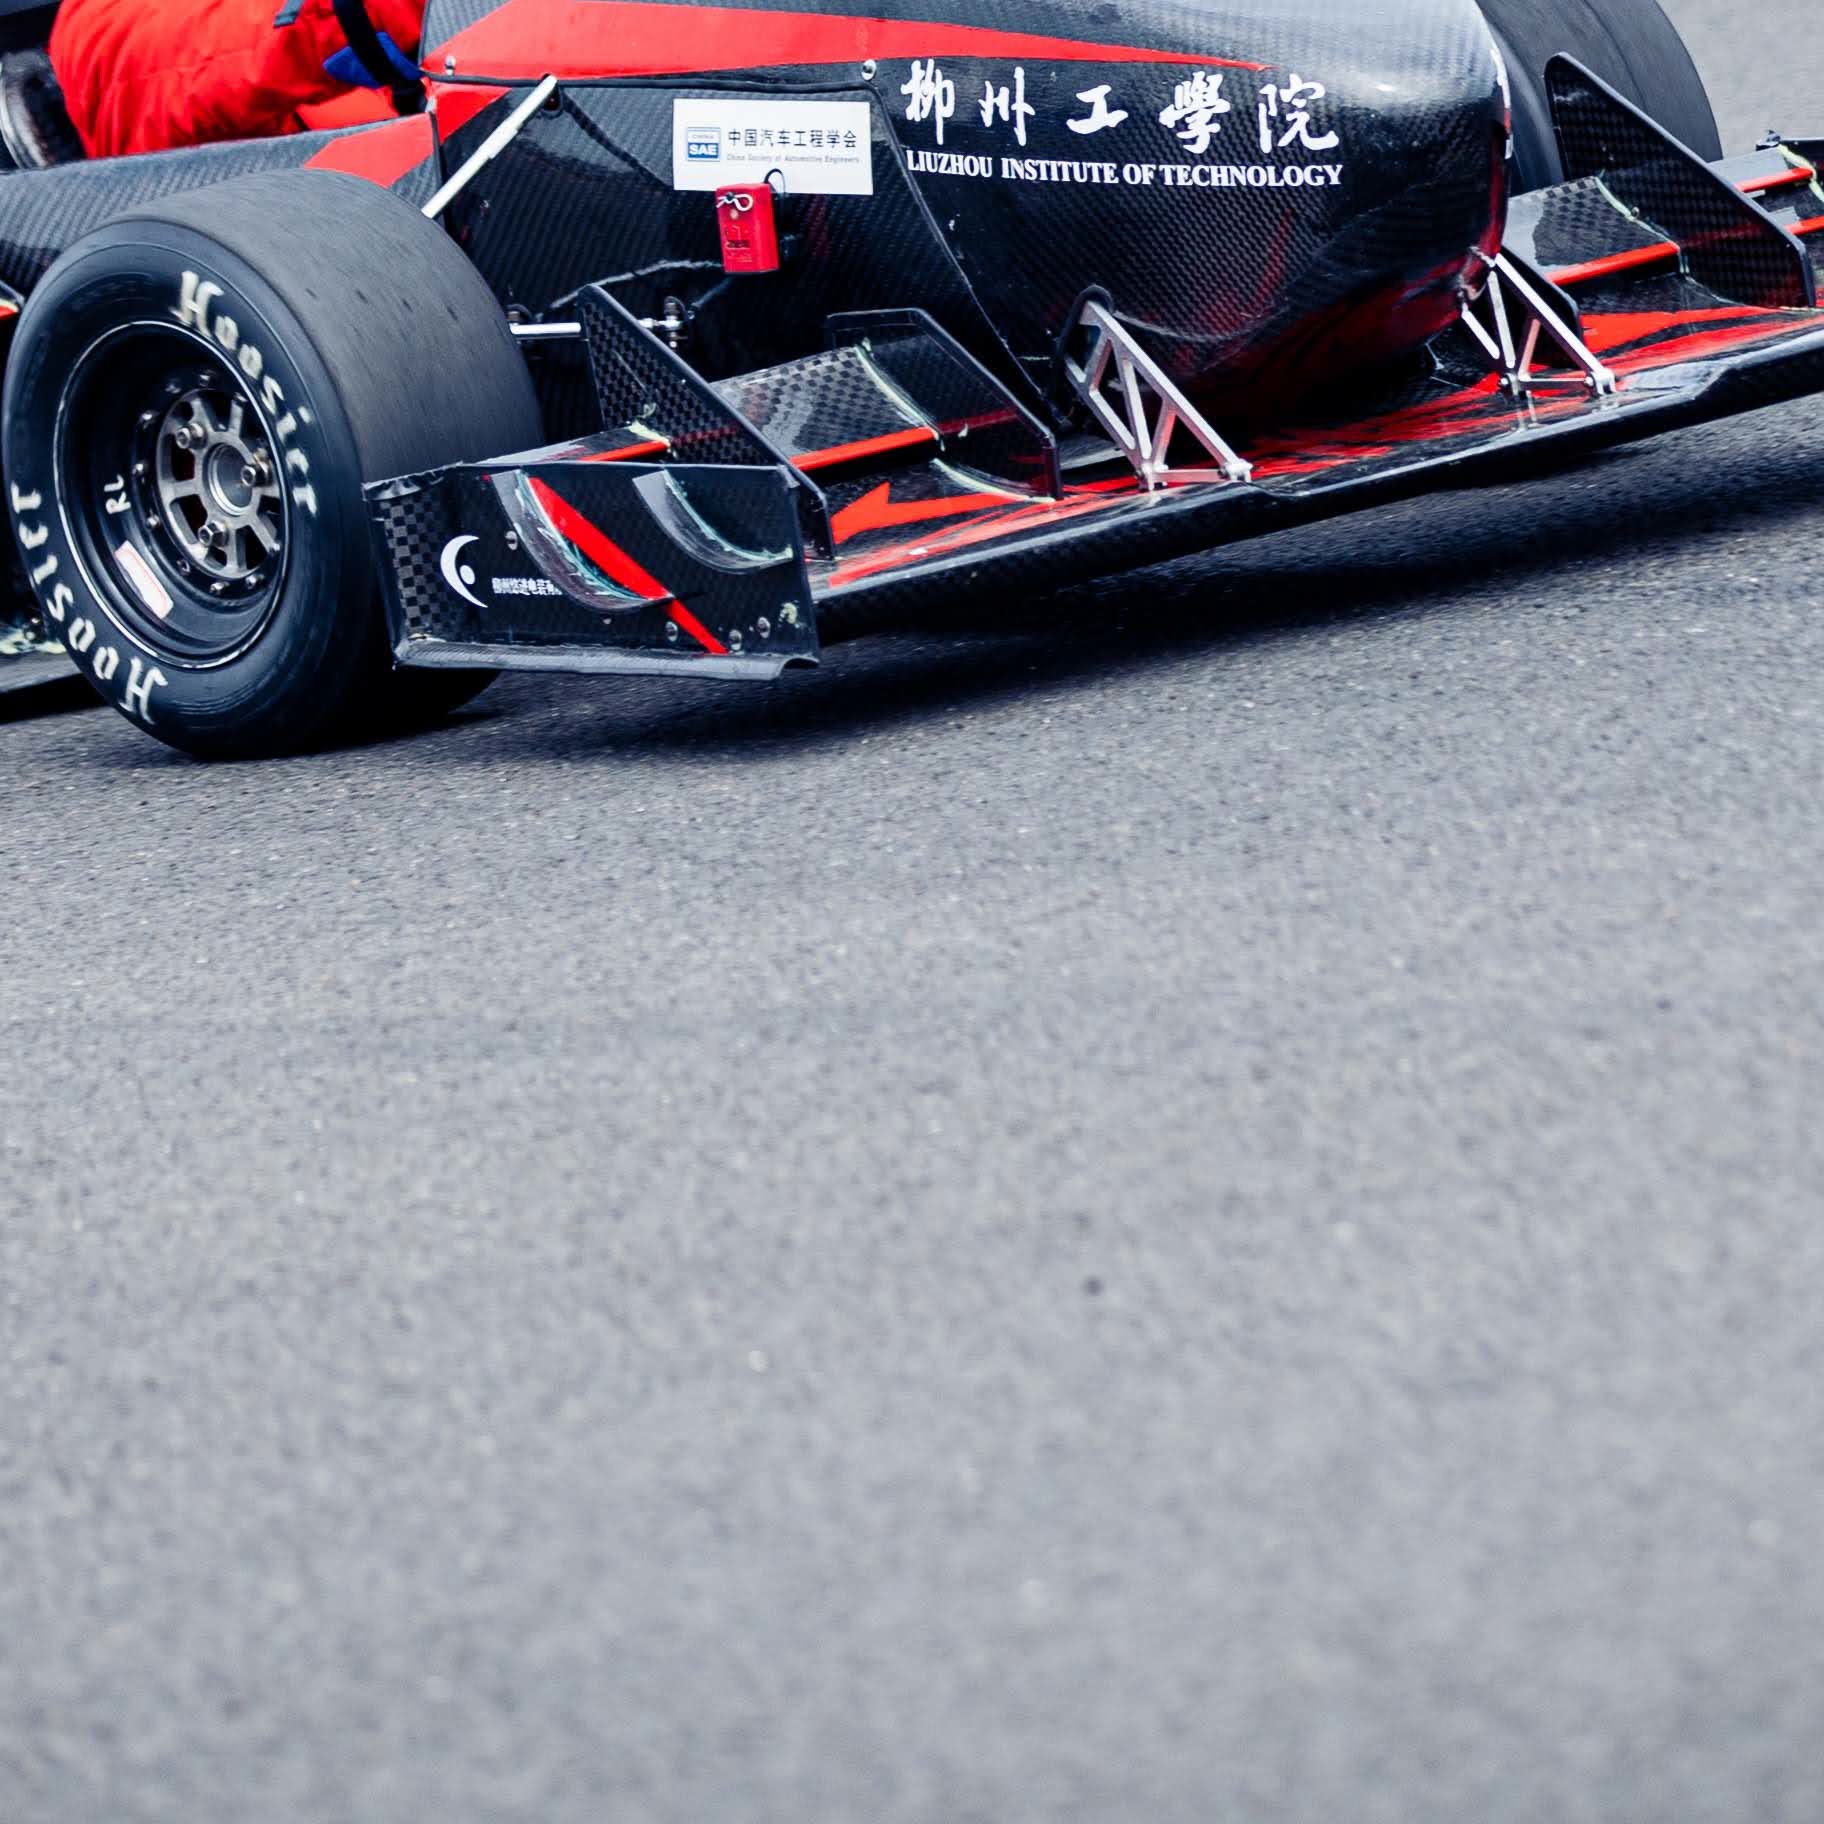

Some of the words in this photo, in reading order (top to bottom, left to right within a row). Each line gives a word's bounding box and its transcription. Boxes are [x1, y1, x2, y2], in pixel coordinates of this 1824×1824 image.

[728, 128, 857, 149] 中国汽车工程学会
[689, 144, 718, 157] SAE
[905, 149, 993, 178] LIUZHOU
[1001, 157, 1120, 185] INSTITUTE
[1122, 163, 1157, 185] OF
[1158, 164, 1344, 187] TECHNOLOGY
